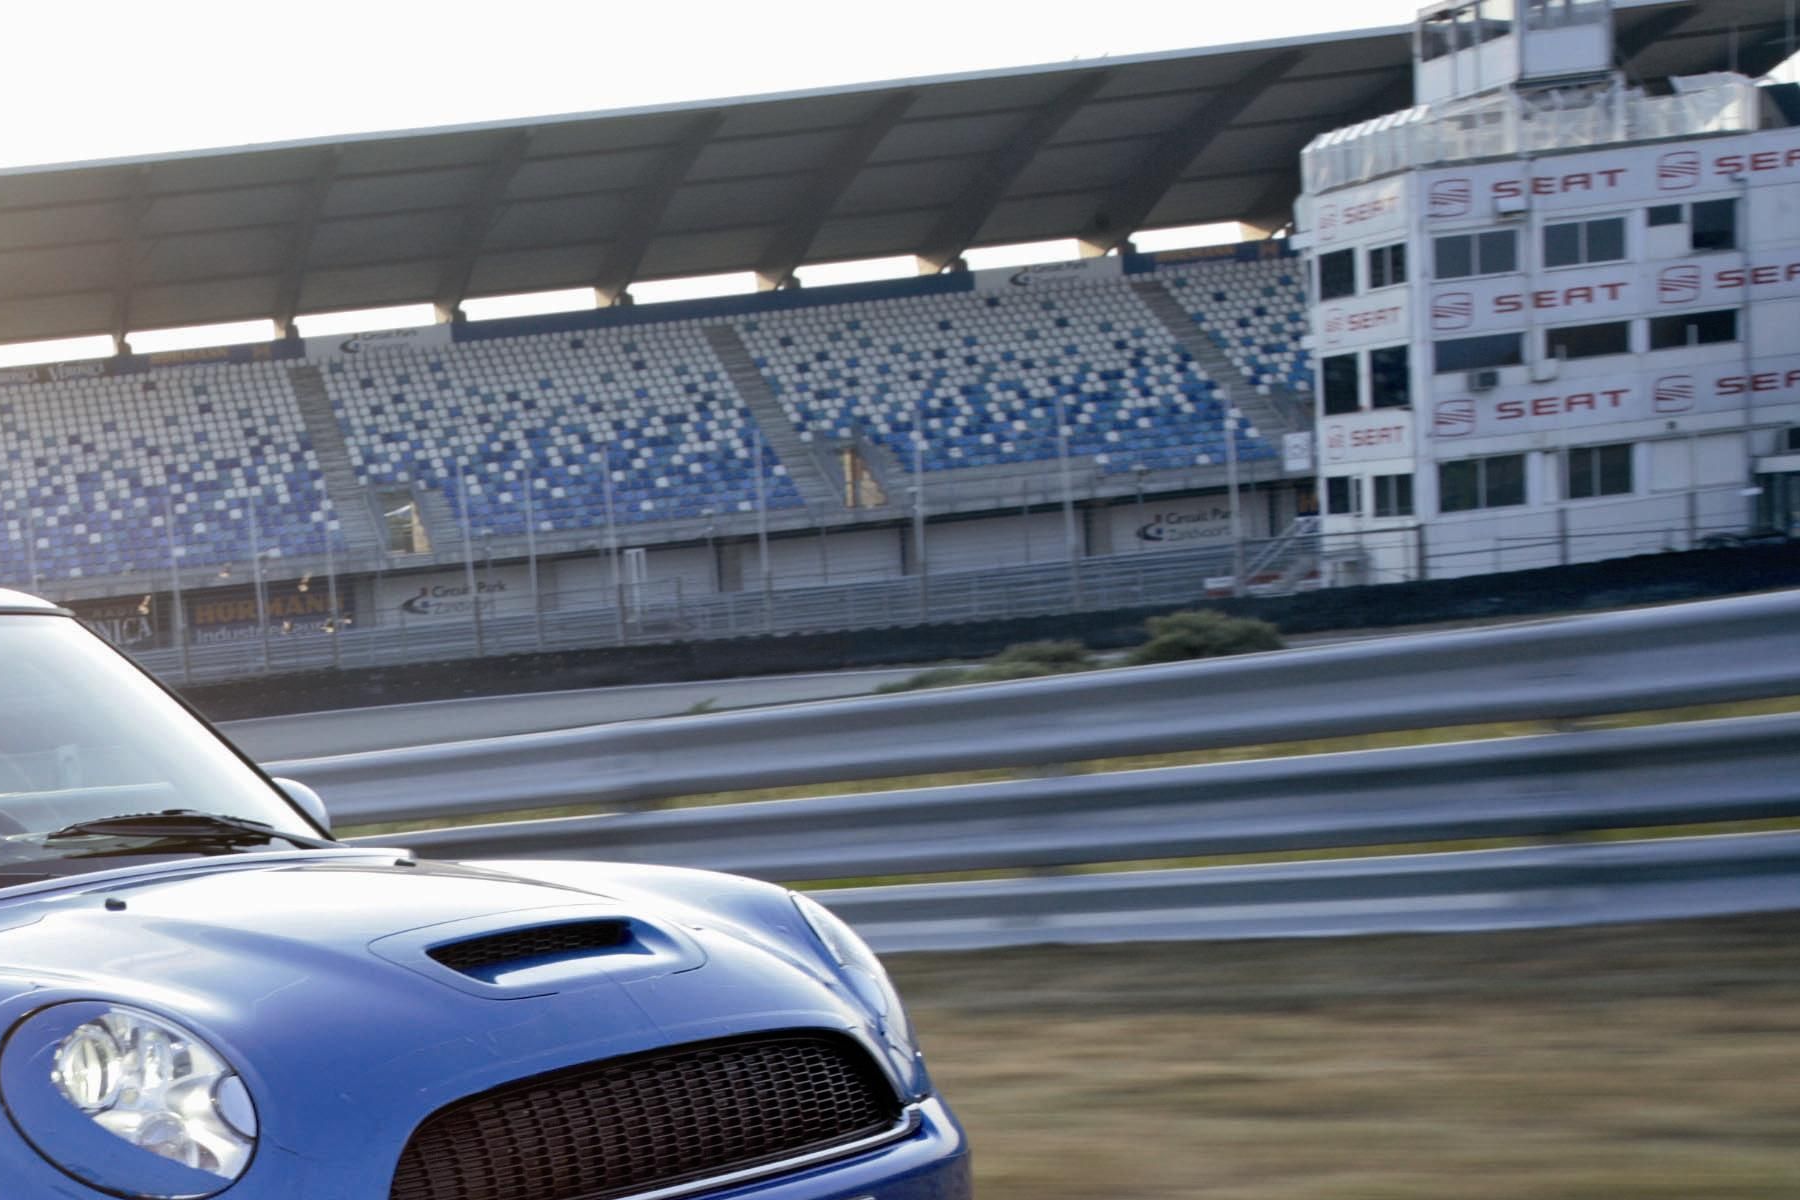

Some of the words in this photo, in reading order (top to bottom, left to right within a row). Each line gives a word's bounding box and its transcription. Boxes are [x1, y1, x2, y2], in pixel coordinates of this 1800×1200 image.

[1491, 168, 1627, 200] SEAT
[1343, 196, 1400, 225] SEAT
[1493, 282, 1630, 313] SEAT
[1347, 306, 1402, 332] SEAT
[1496, 389, 1631, 421] SEAT
[1351, 425, 1405, 447] SEAT
